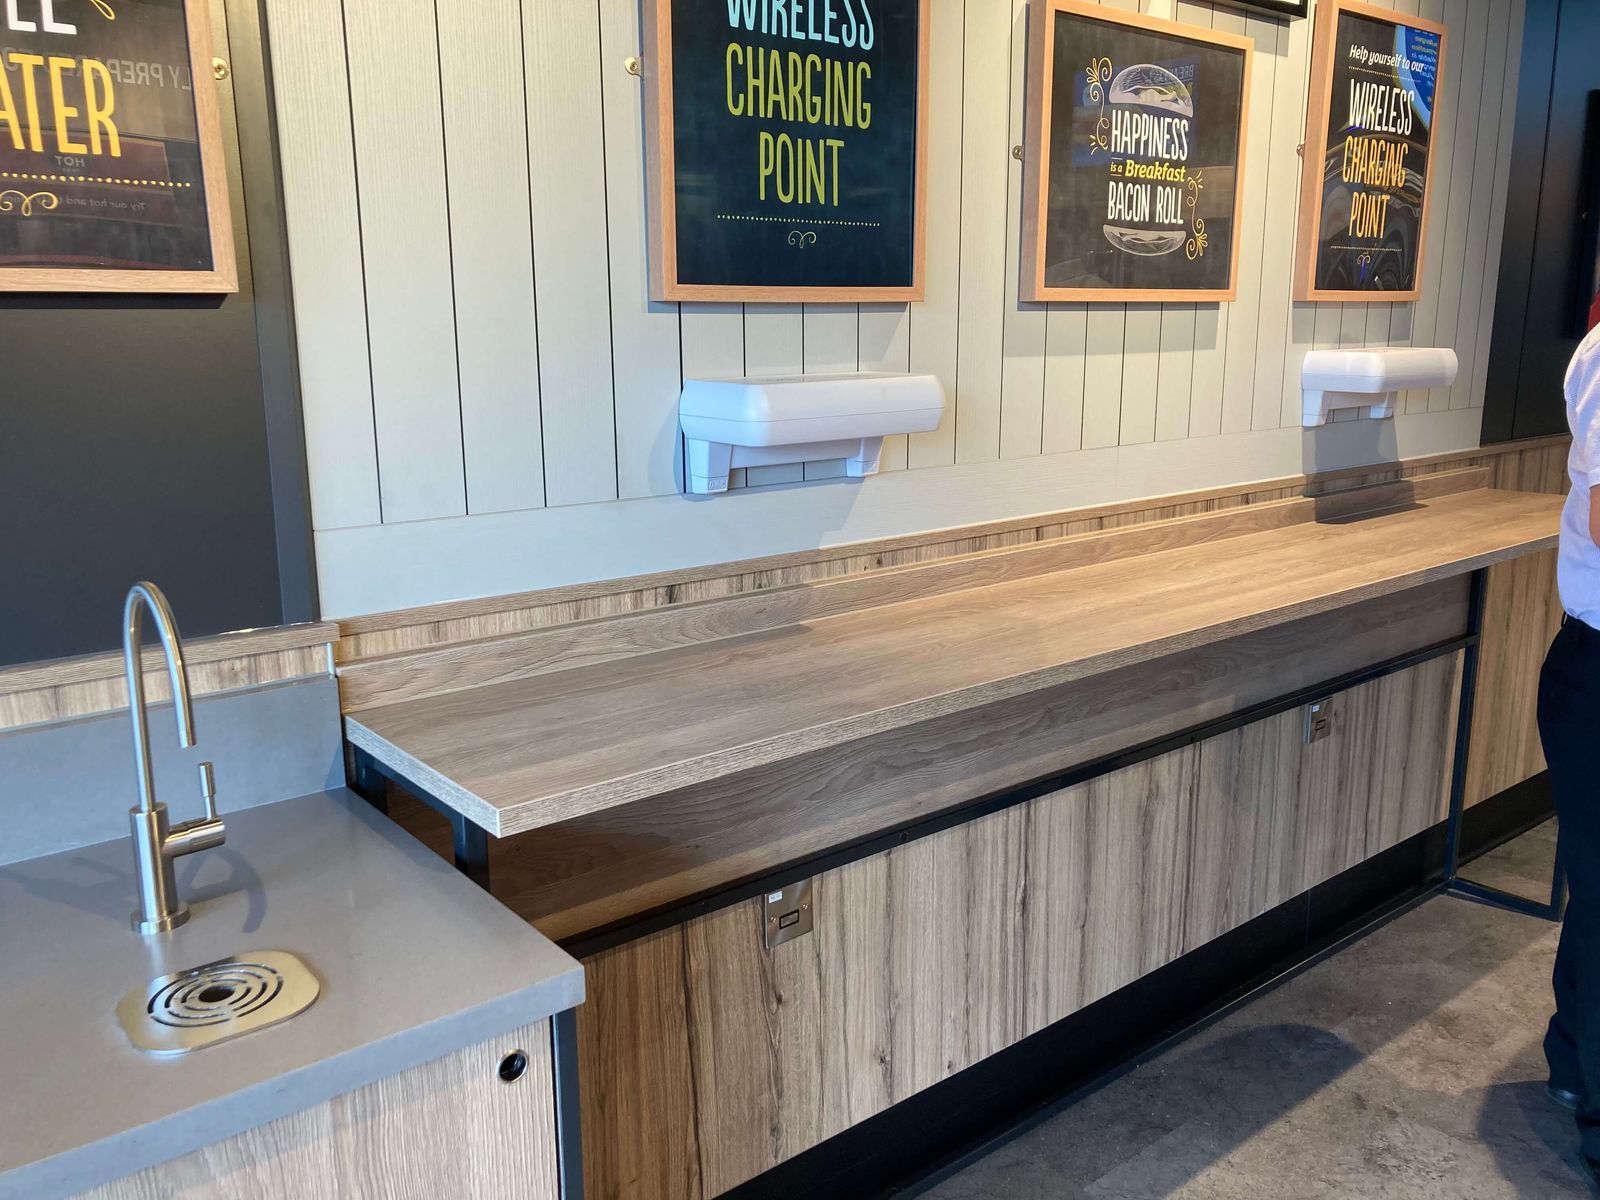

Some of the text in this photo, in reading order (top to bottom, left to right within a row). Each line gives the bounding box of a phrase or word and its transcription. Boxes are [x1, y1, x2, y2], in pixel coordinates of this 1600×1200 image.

[1349, 44, 1368, 64] Help
[1368, 50, 1402, 68] yourself
[1402, 56, 1410, 70] to
[1411, 60, 1425, 73] our
[726, 42, 873, 130] CHARGING
[1349, 78, 1415, 136] WIRELESS
[1110, 109, 1189, 161] HAPPINESS
[759, 131, 845, 207] POINT
[1110, 159, 1186, 182] is a Breakfast
[1342, 135, 1409, 188] CHARGING
[1107, 180, 1184, 224] BACON ROLL
[1348, 190, 1390, 239] POINT
